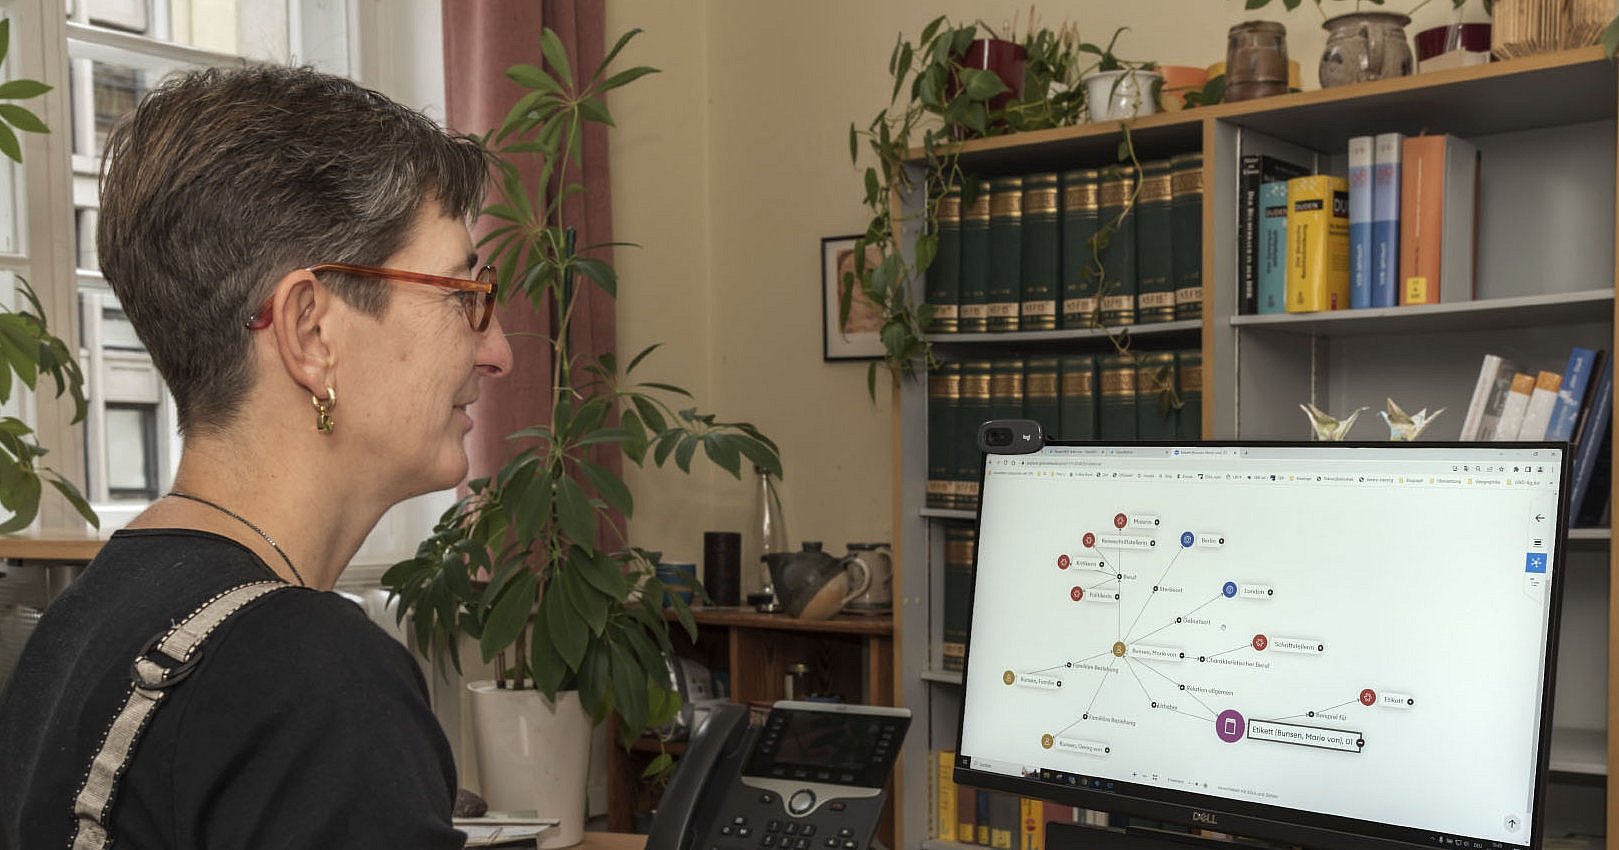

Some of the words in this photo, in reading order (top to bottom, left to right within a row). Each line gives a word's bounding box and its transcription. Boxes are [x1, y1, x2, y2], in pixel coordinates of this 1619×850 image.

[1252, 725, 1274, 736] Etikett
[1274, 728, 1304, 740] (Bunsen,
[1192, 811, 1218, 825] DELL
